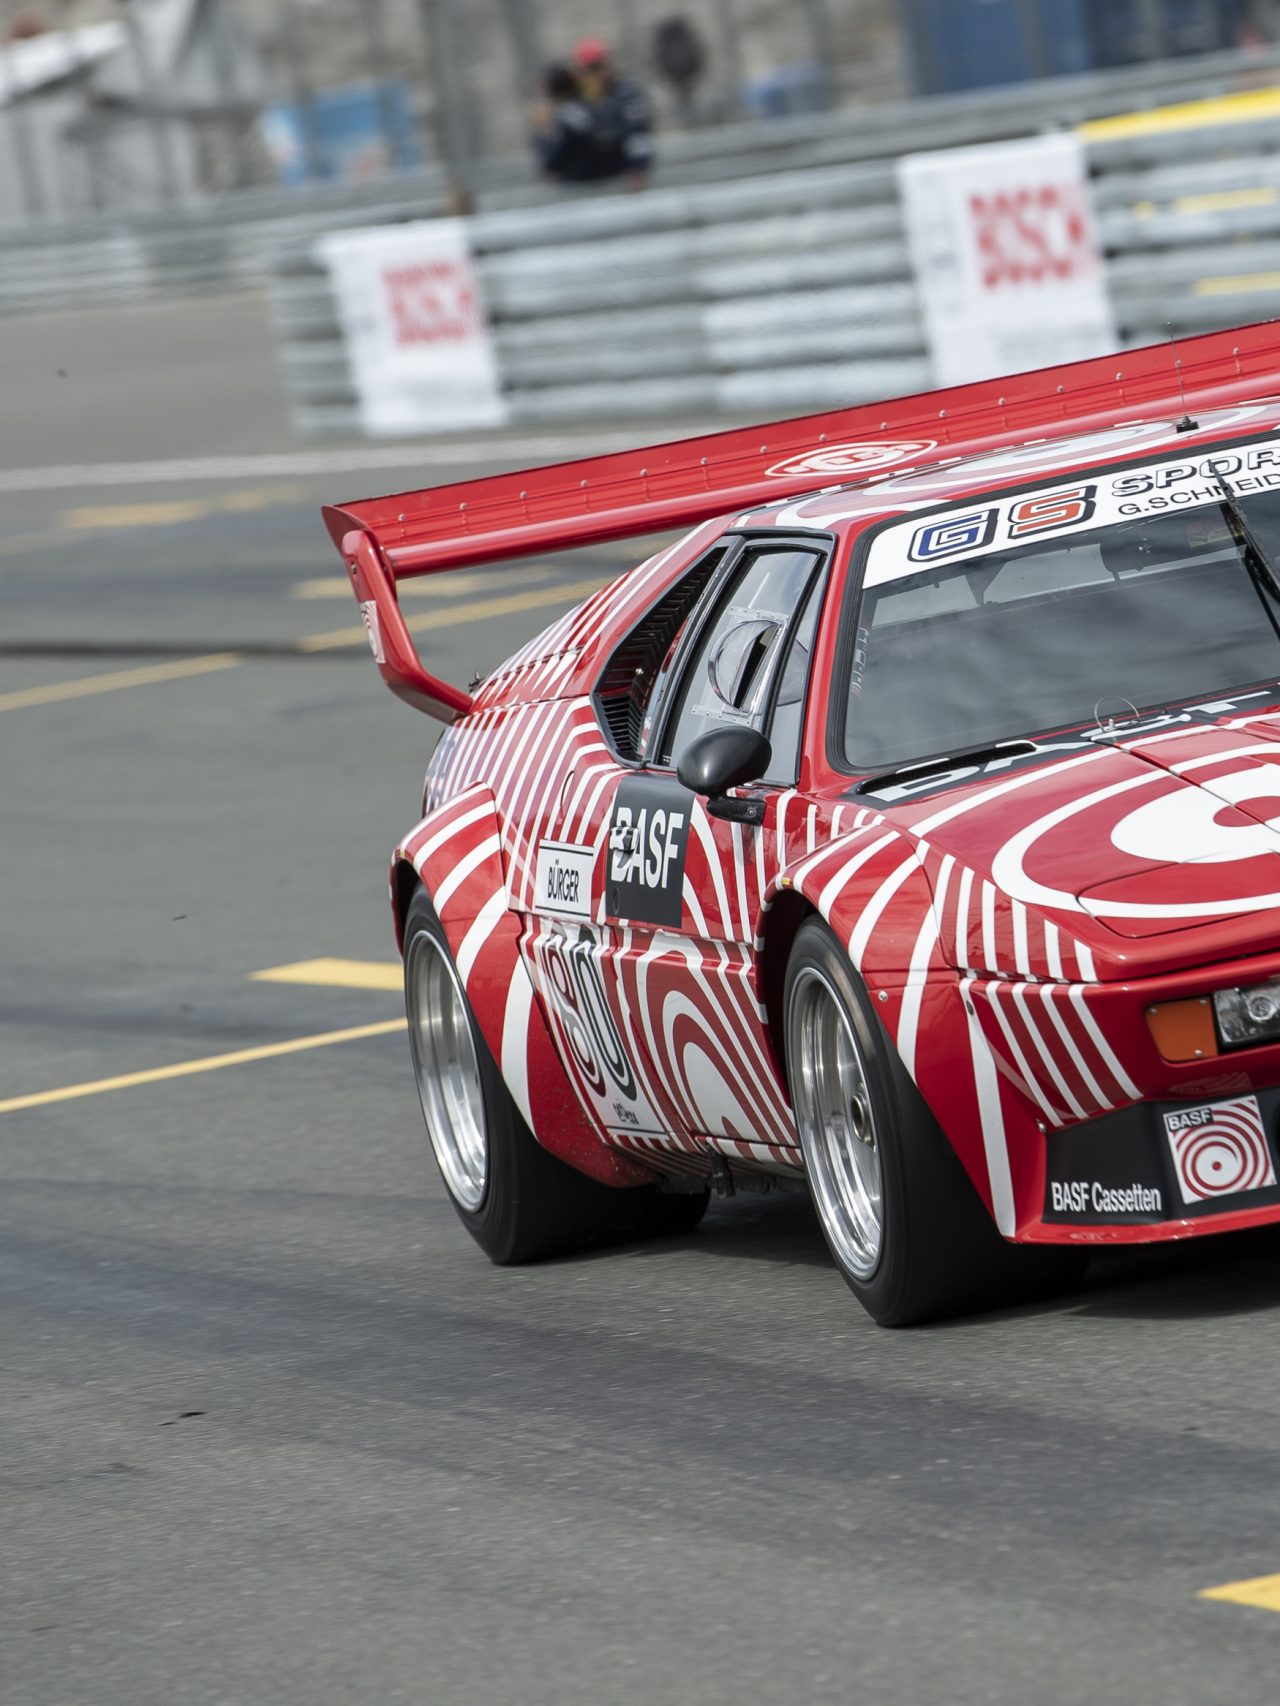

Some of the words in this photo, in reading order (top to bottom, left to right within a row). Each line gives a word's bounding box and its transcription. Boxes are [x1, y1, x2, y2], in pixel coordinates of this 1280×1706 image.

[609, 807, 684, 889] BASF
[547, 858, 580, 903] BÜRGER
[1168, 1109, 1211, 1130] BASF
[1051, 1181, 1090, 1212] BASF
[1092, 1181, 1162, 1213] Cassetten
